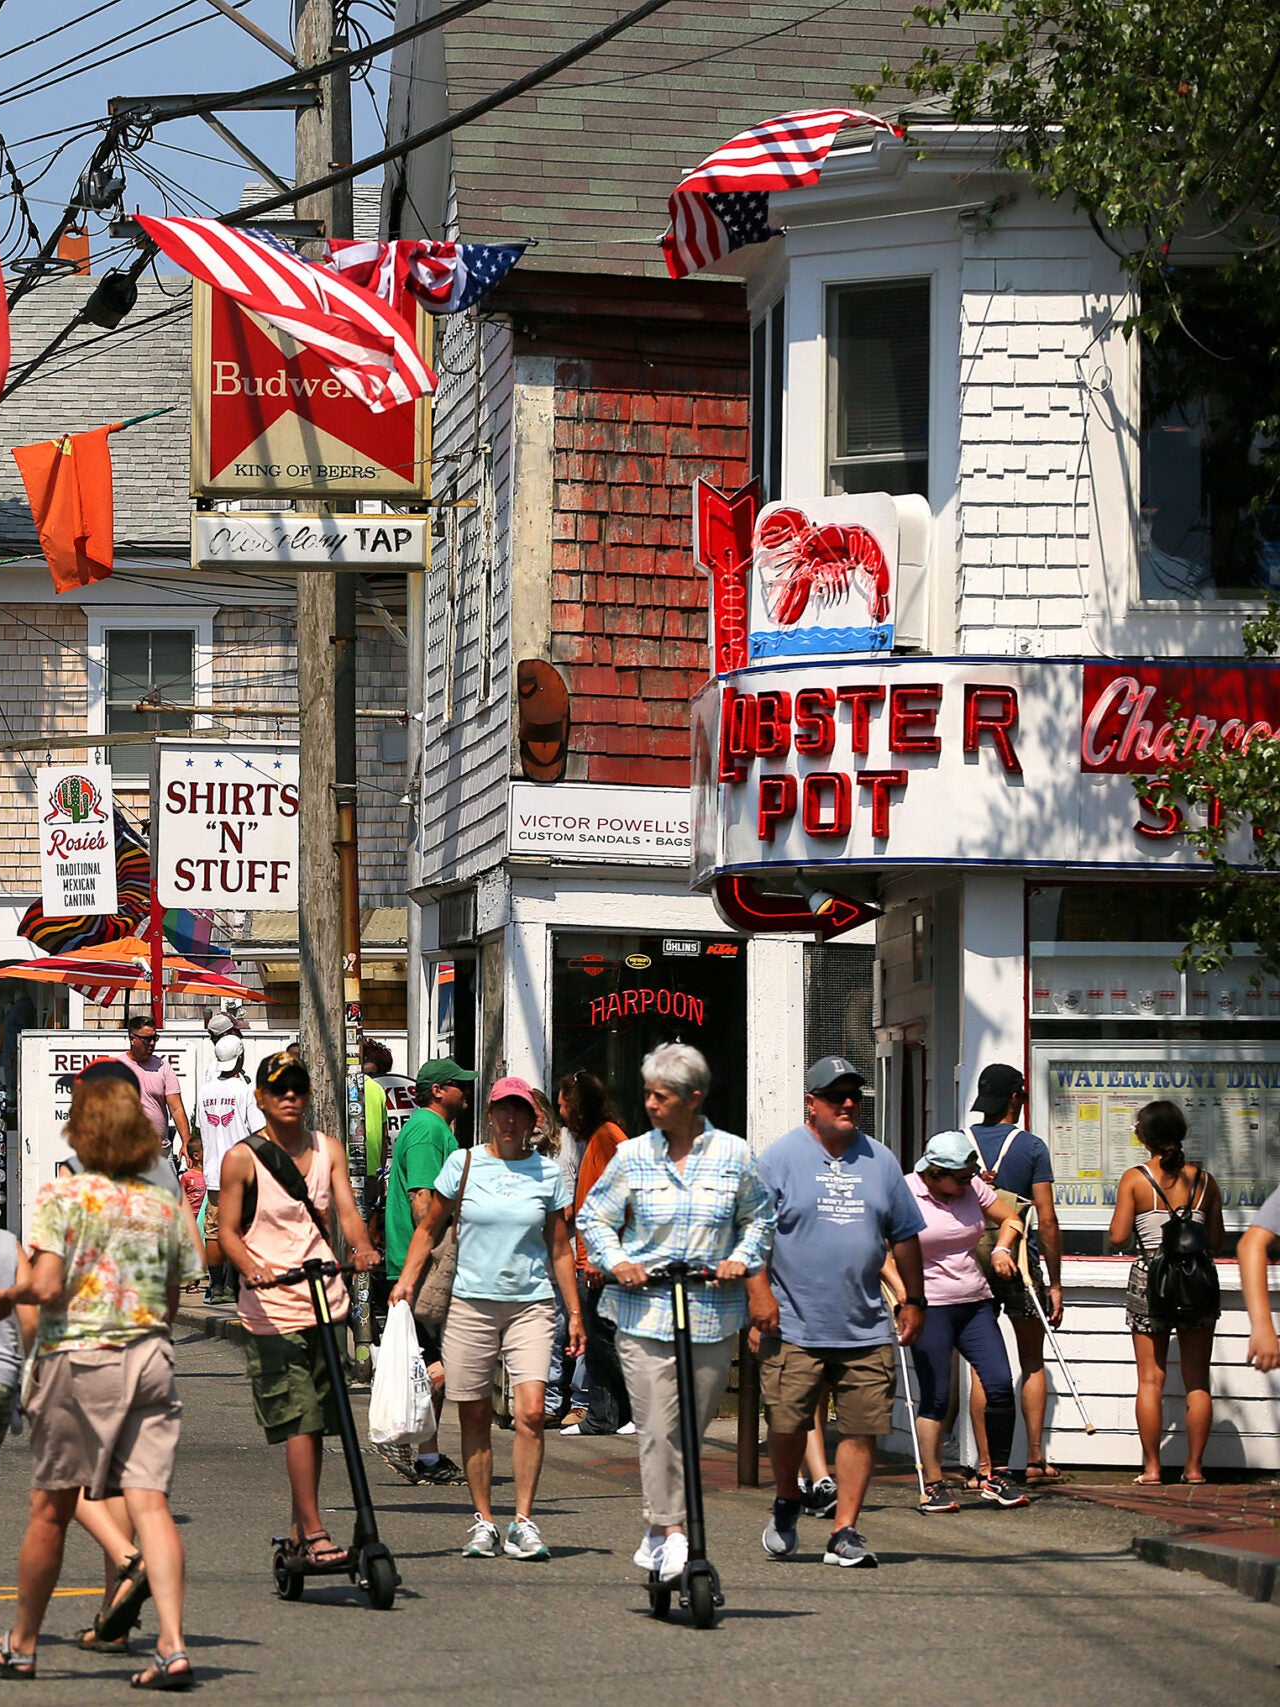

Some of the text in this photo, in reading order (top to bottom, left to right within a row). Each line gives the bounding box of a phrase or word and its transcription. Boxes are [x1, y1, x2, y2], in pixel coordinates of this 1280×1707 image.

[234, 463, 376, 479] KING OF BEERS
[354, 527, 413, 552] TAP
[165, 780, 299, 817] SHIRTS
[758, 769, 909, 842] POT
[519, 815, 690, 834] VICTOR POWELL'S
[47, 829, 109, 860] Rosie's
[518, 831, 692, 847] CUSTOM SANDALS BAGS
[55, 862, 102, 877] TRADITIONAL
[174, 858, 291, 893] STUFF
[63, 878, 96, 891] MEXICAN
[64, 893, 96, 907] CANTINA
[665, 940, 739, 955] ÖHLINS KTM
[589, 989, 704, 1026] HARPOON
[1056, 1063, 1217, 1088] WATERFRONT
[1055, 1184, 1096, 1205] FULL
